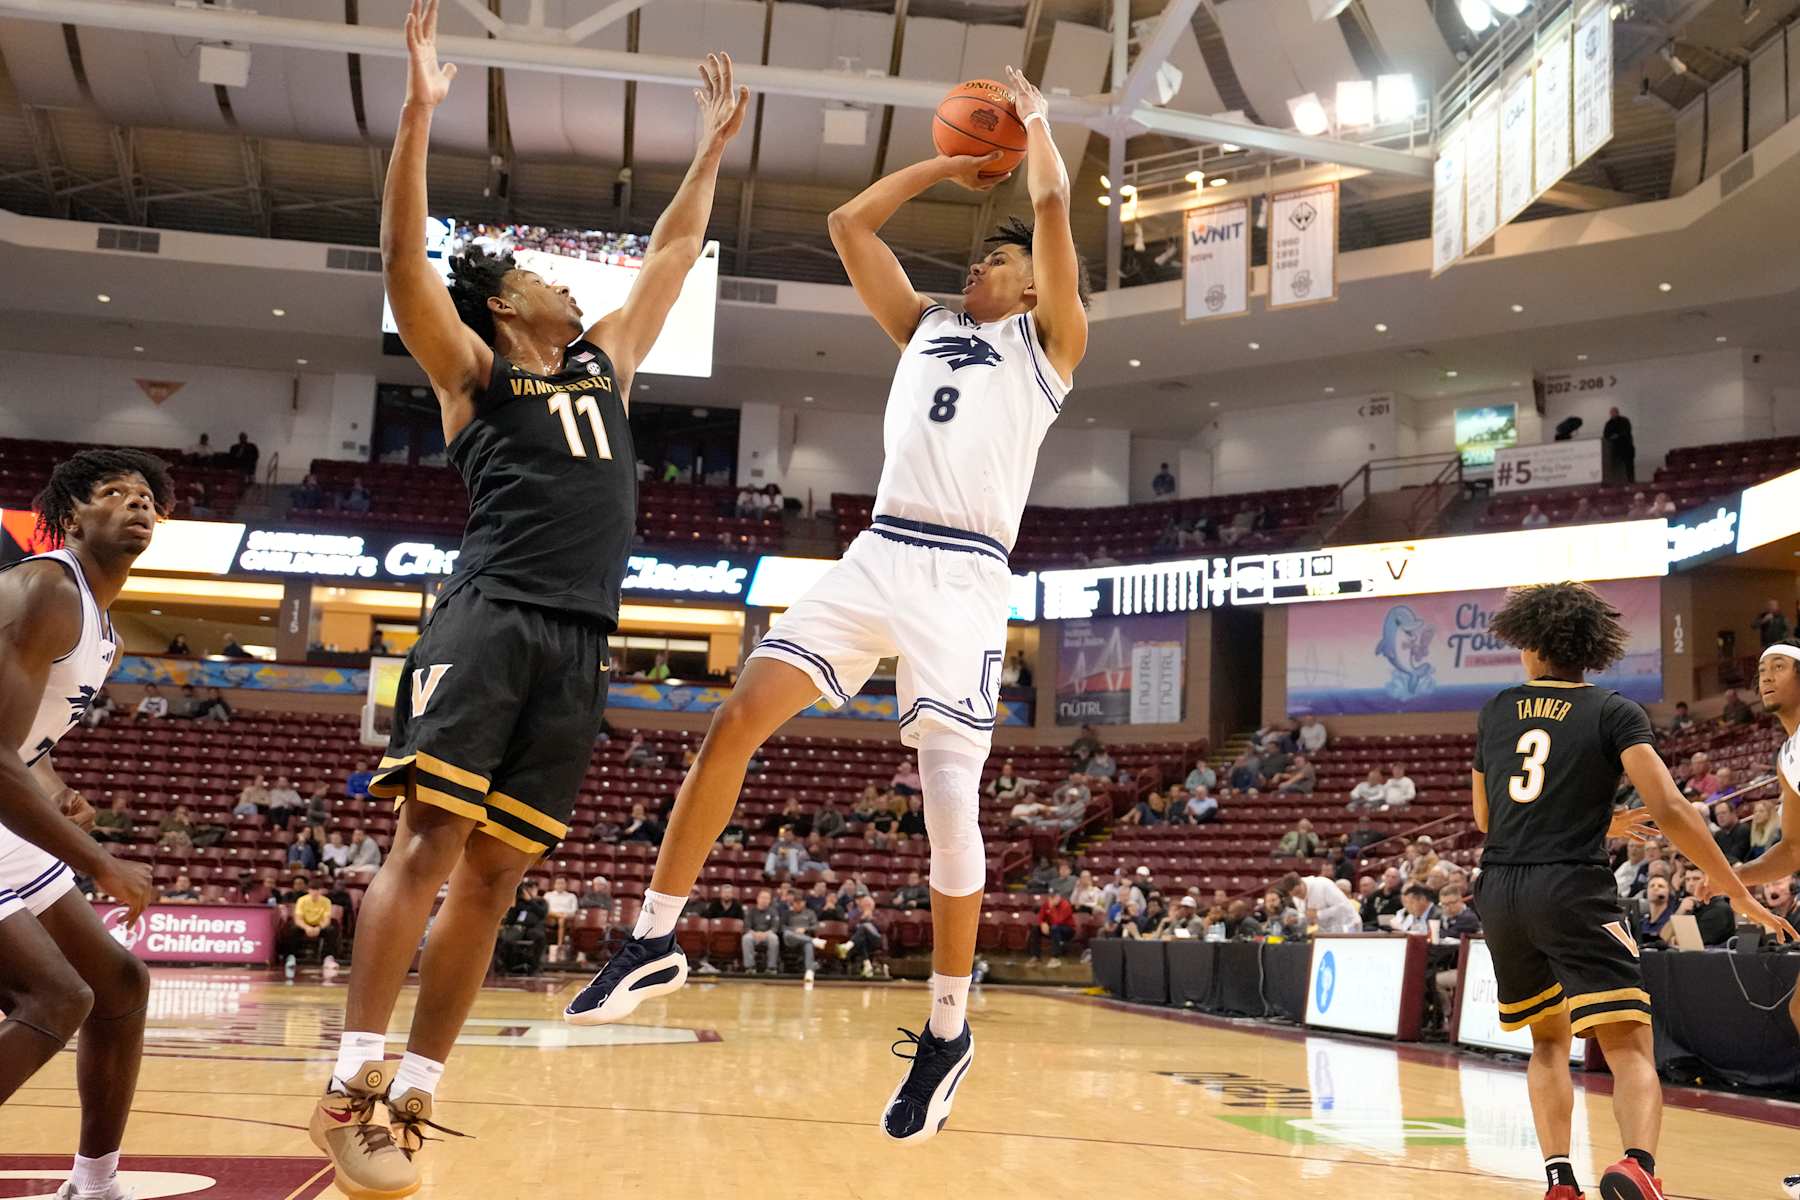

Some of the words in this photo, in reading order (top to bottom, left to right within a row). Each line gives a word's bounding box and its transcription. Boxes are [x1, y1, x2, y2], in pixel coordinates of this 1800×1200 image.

[1191, 222, 1244, 246] WNIT
[510, 376, 612, 396] VANDERBILT
[1547, 377, 1604, 394] 202-208
[929, 386, 961, 423] 8
[547, 391, 613, 460] 11
[1516, 697, 1572, 722] TANNER
[1508, 728, 1552, 804] 3
[149, 912, 247, 934] Shriners
[146, 933, 255, 954] Children's
